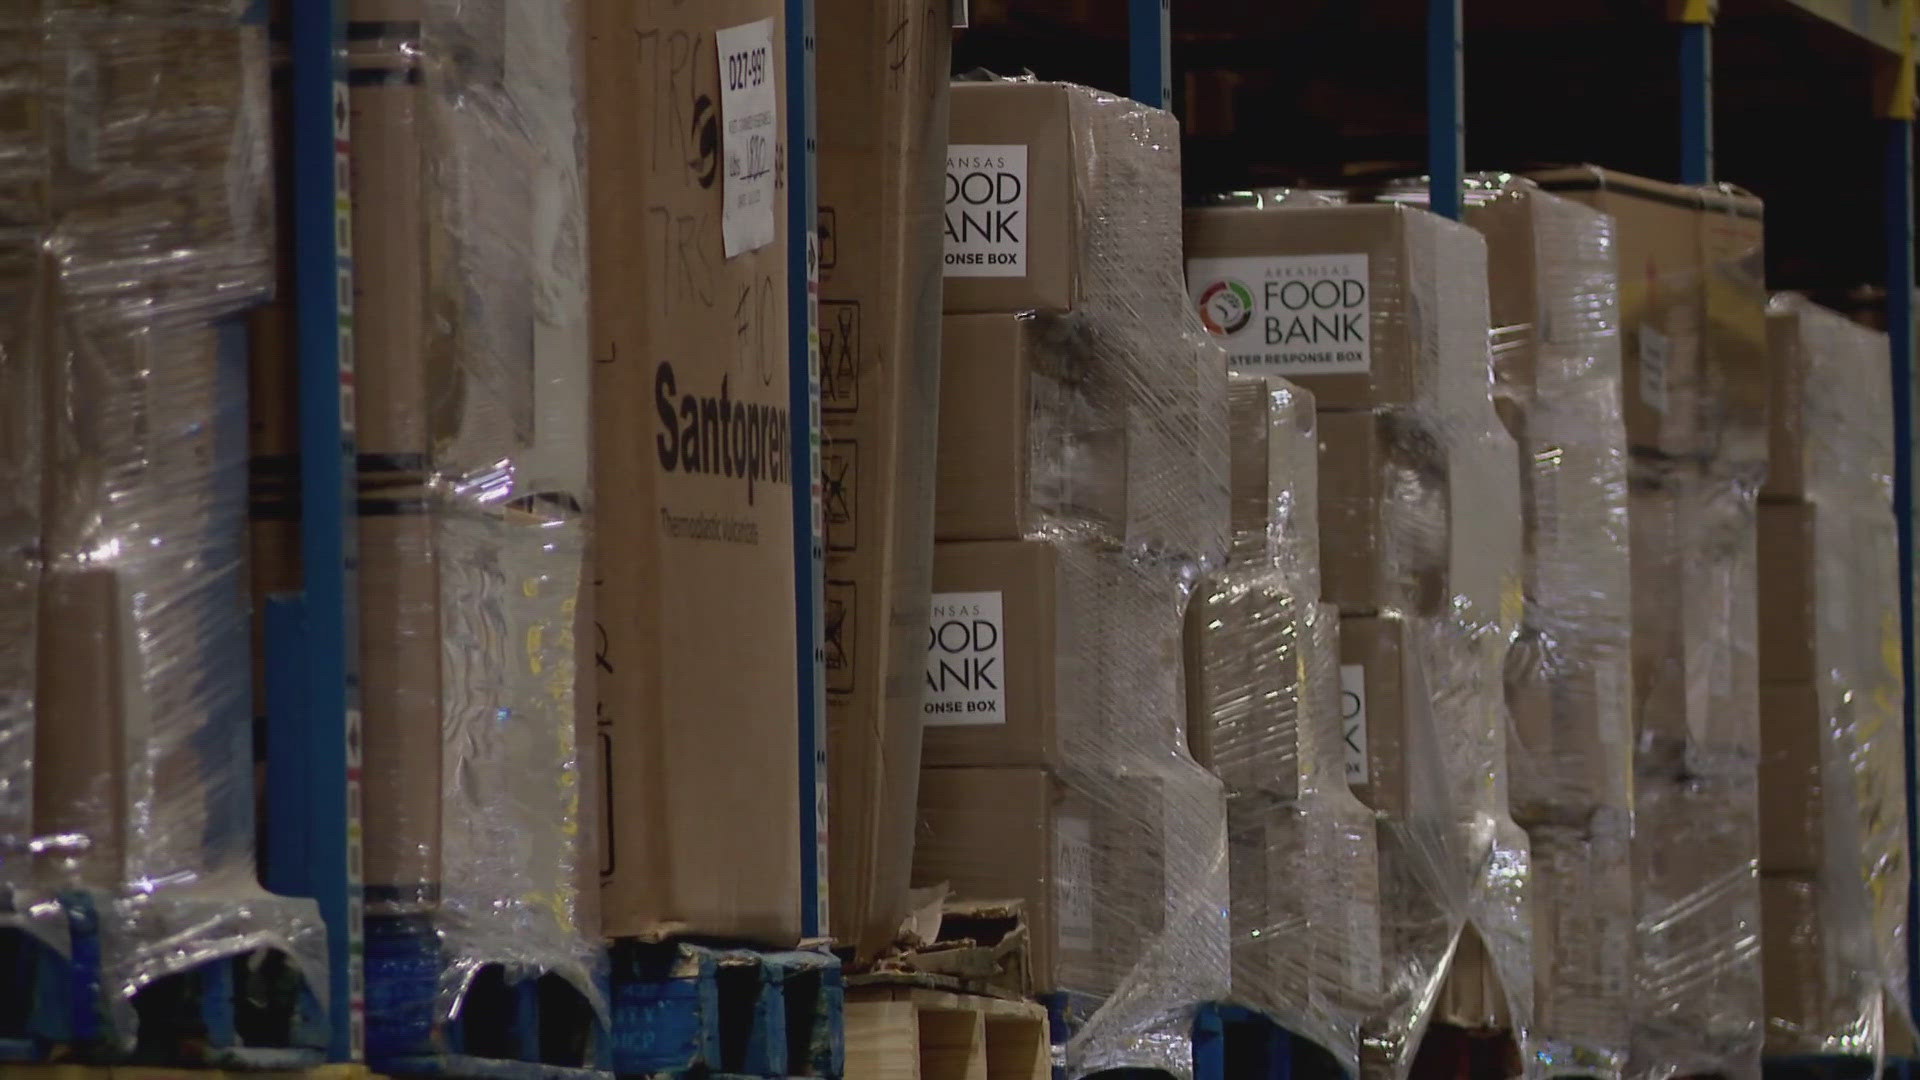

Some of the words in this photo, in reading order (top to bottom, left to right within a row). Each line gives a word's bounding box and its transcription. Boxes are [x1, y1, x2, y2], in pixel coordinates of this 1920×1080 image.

[946, 157, 1005, 168] ANSAS
[945, 253, 983, 264] ONSE
[988, 253, 1017, 264] BOX
[1265, 265, 1350, 277] ARKANSAS
[1264, 279, 1365, 311] FOOD
[1264, 313, 1364, 345] BANK
[1229, 354, 1261, 366] STER
[1264, 351, 1332, 364] RESPONSE
[1336, 350, 1362, 362] BOX
[934, 605, 981, 617] NSAS
[924, 701, 963, 714] ONSE
[967, 700, 996, 713] BOX
